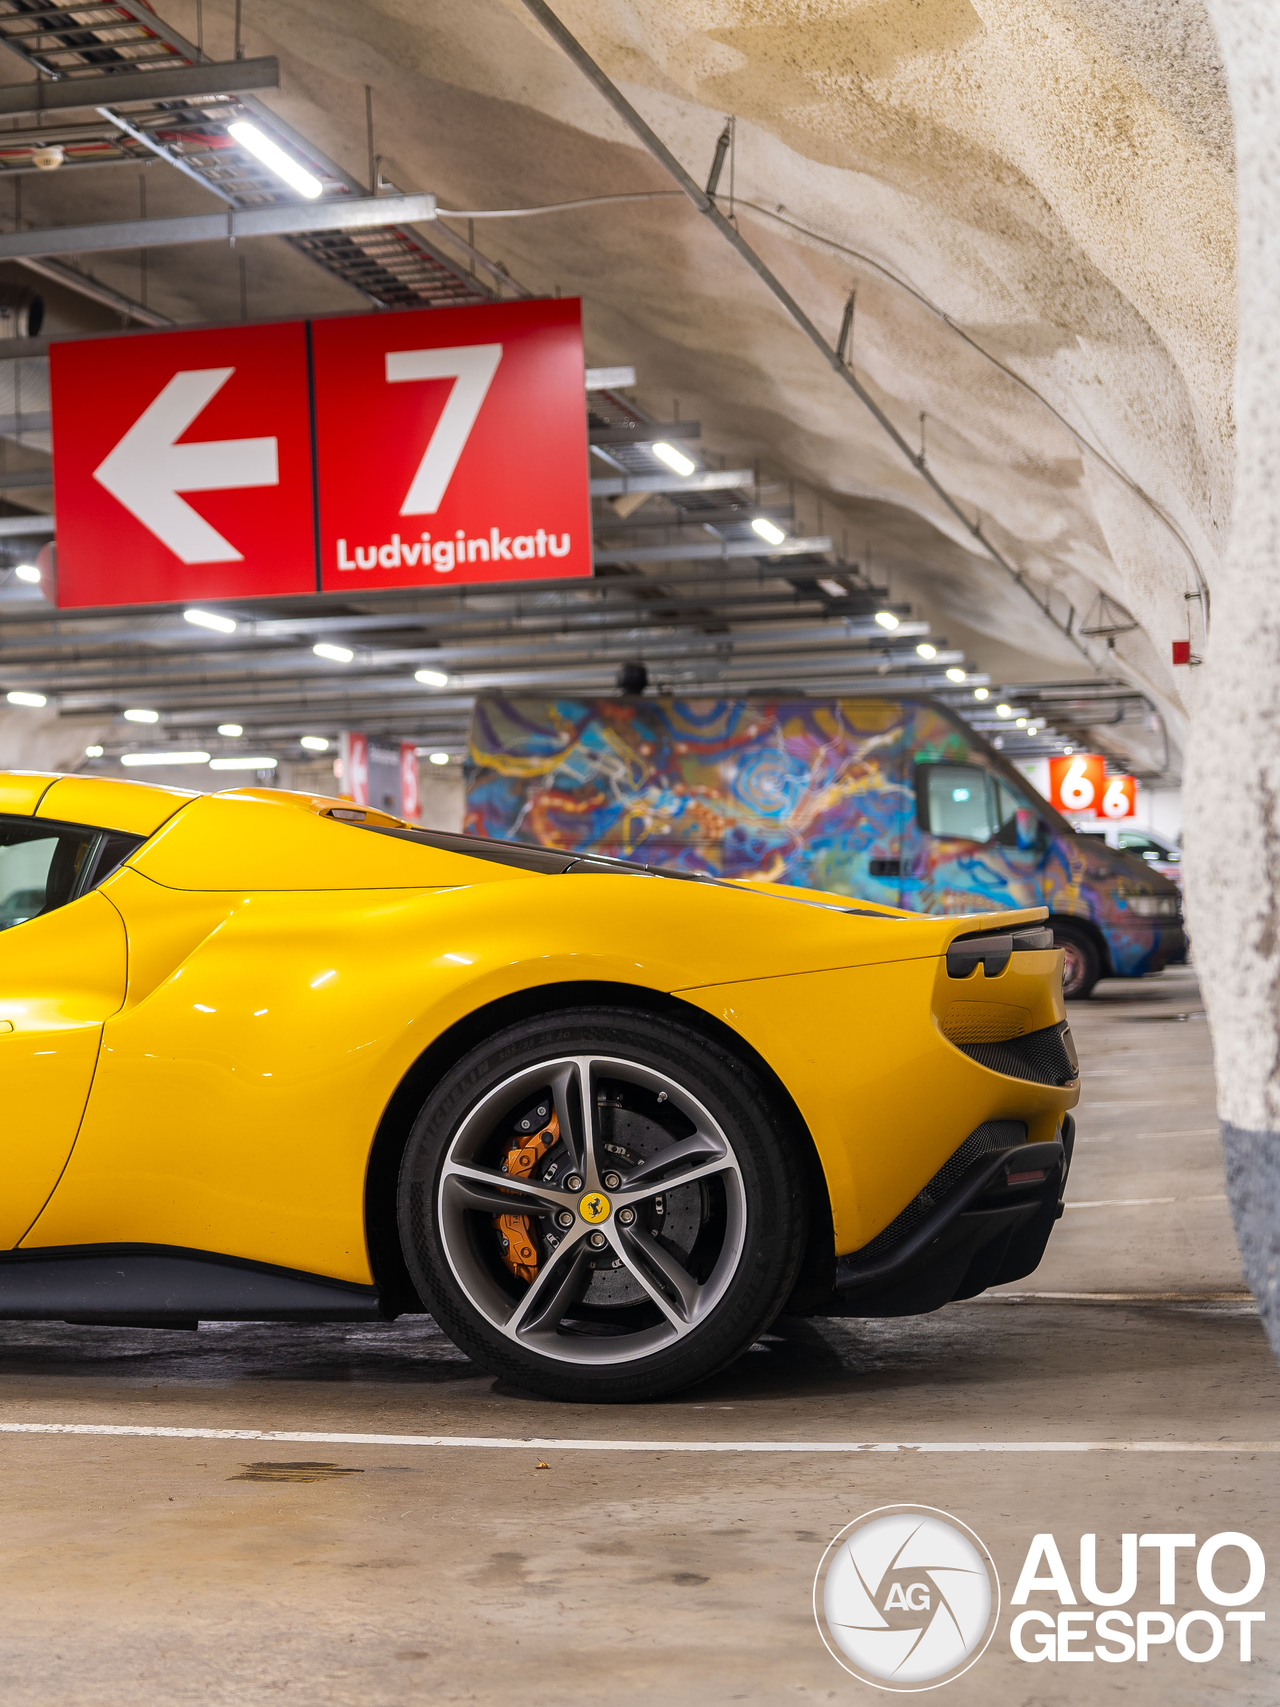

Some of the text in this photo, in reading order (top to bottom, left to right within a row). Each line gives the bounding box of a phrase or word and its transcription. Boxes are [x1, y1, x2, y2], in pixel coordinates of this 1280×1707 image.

[384, 342, 503, 516] 7
[336, 527, 571, 573] Ludviginkatu
[1059, 757, 1095, 810] 6
[1102, 780, 1130, 819] 6
[422, 1060, 491, 1148] MICHELIN
[556, 1031, 571, 1040] 20
[614, 1373, 652, 1389] SPORT
